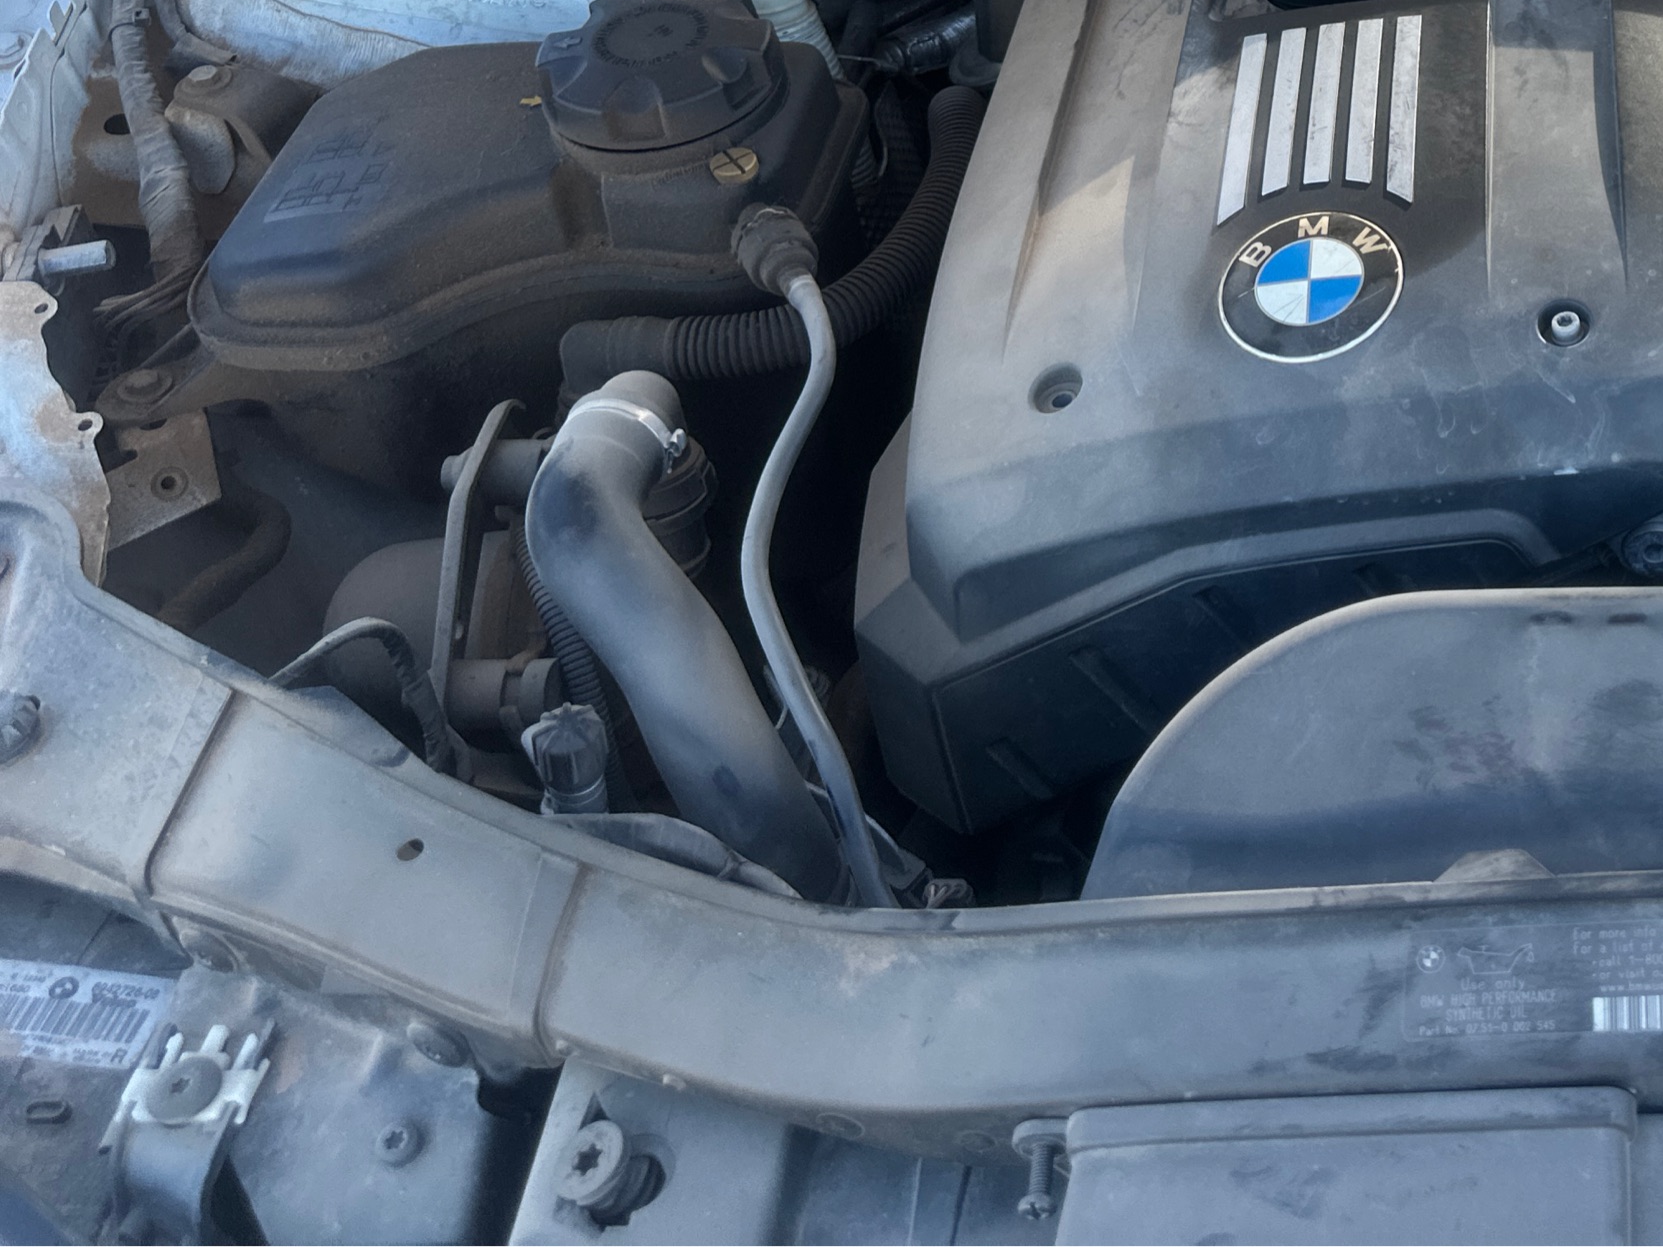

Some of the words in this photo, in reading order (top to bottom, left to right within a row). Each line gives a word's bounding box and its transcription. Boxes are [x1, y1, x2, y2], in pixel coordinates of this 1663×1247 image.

[1239, 215, 1390, 268] BMW
[1461, 977, 1485, 990] Use
[1496, 976, 1525, 990] only
[1446, 1006, 1504, 1022] SYNTHETIC
[1510, 1005, 1528, 1018] OIL
